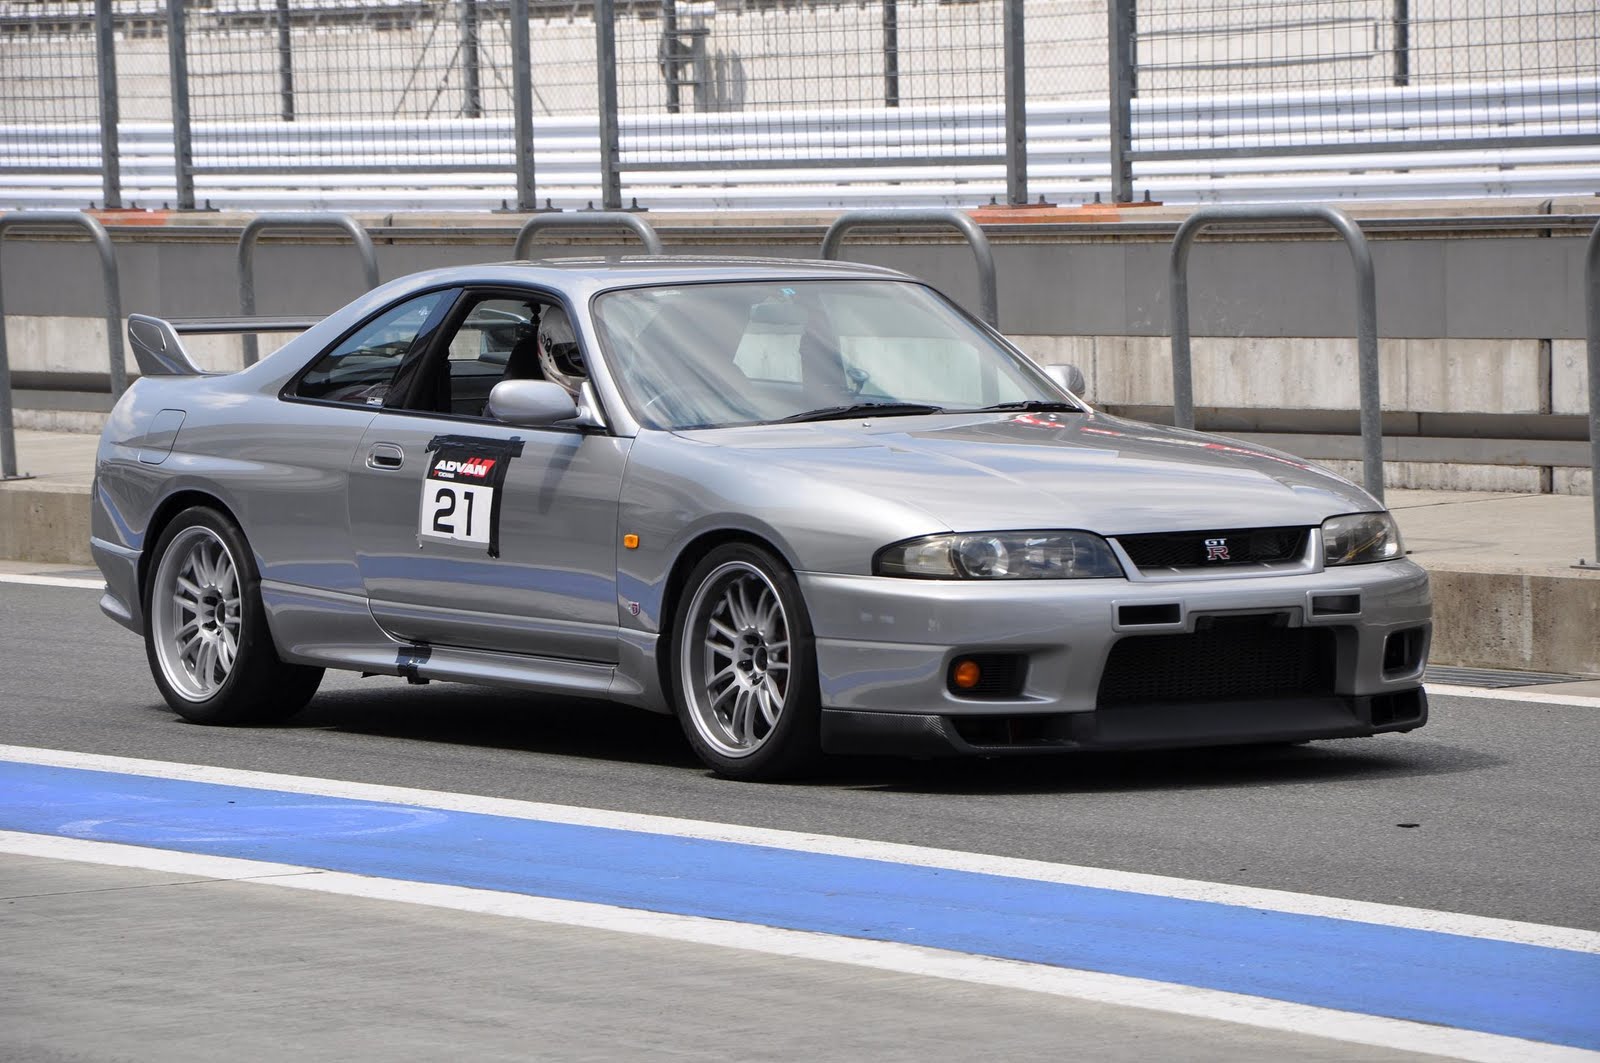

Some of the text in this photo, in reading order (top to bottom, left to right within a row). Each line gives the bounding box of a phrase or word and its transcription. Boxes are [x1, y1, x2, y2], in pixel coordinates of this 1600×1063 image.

[434, 459, 488, 476] ADVAN
[432, 488, 474, 536] 21
[1204, 538, 1227, 546] GT
[1206, 545, 1231, 560] R
